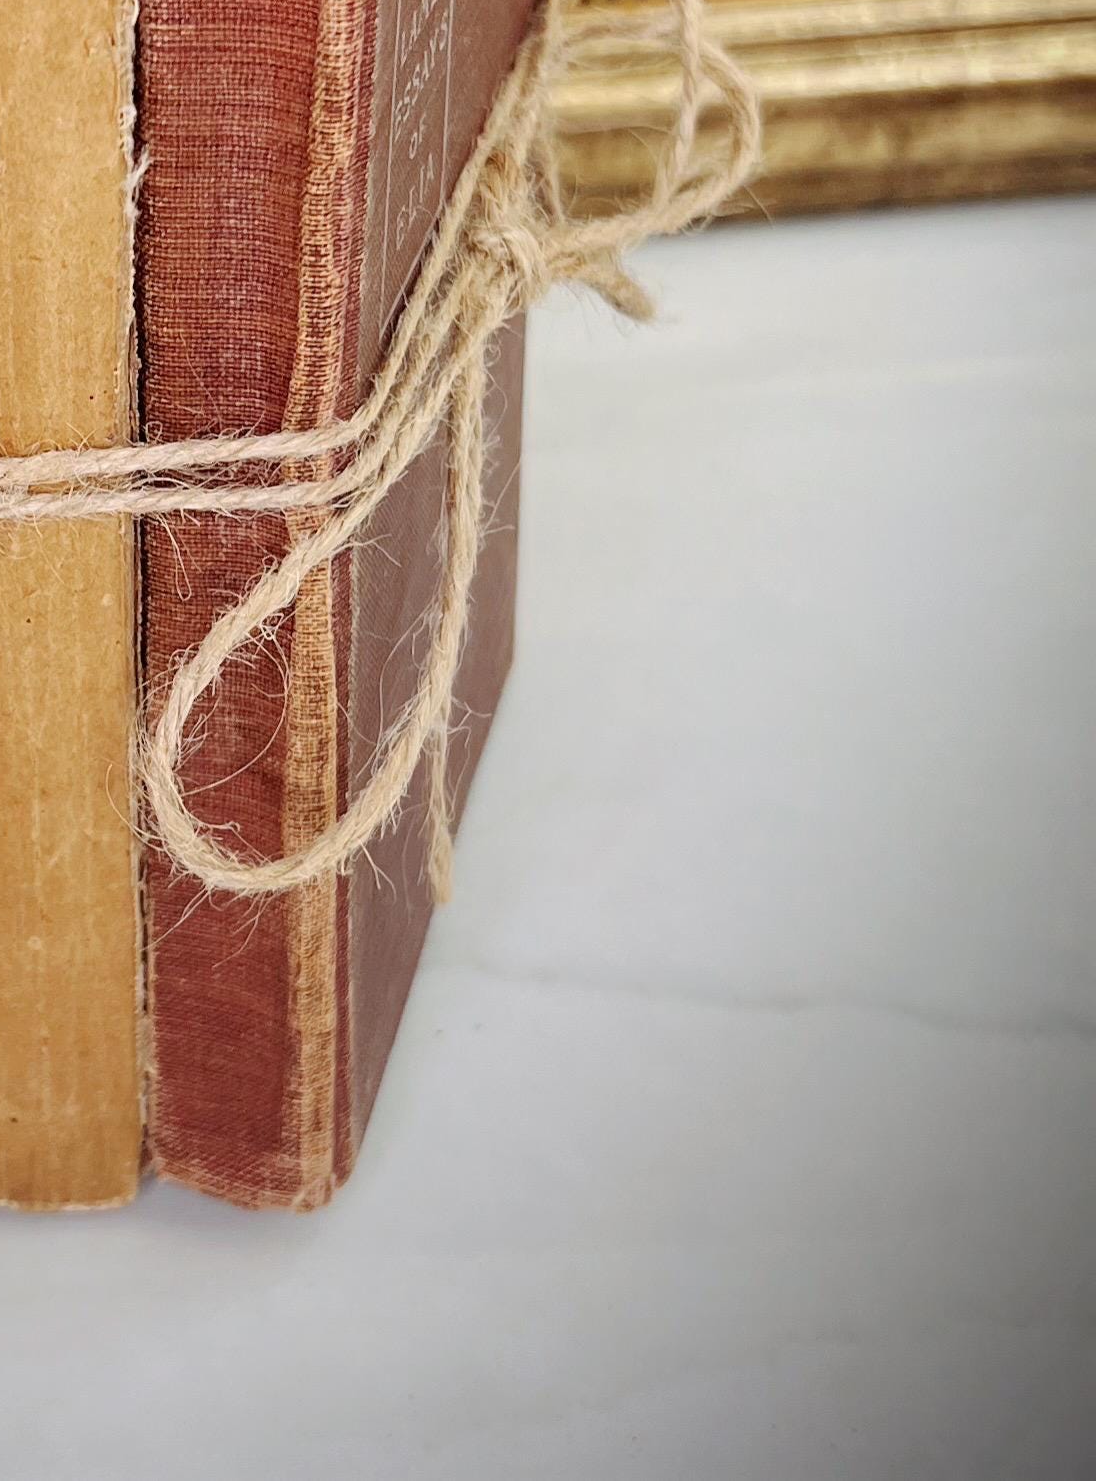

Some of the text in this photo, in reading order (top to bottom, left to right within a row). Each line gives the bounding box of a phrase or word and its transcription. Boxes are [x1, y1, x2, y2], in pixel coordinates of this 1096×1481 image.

[393, 8, 449, 143] ESSAYS
[408, 112, 426, 160] OF
[395, 151, 435, 252] ELIA
